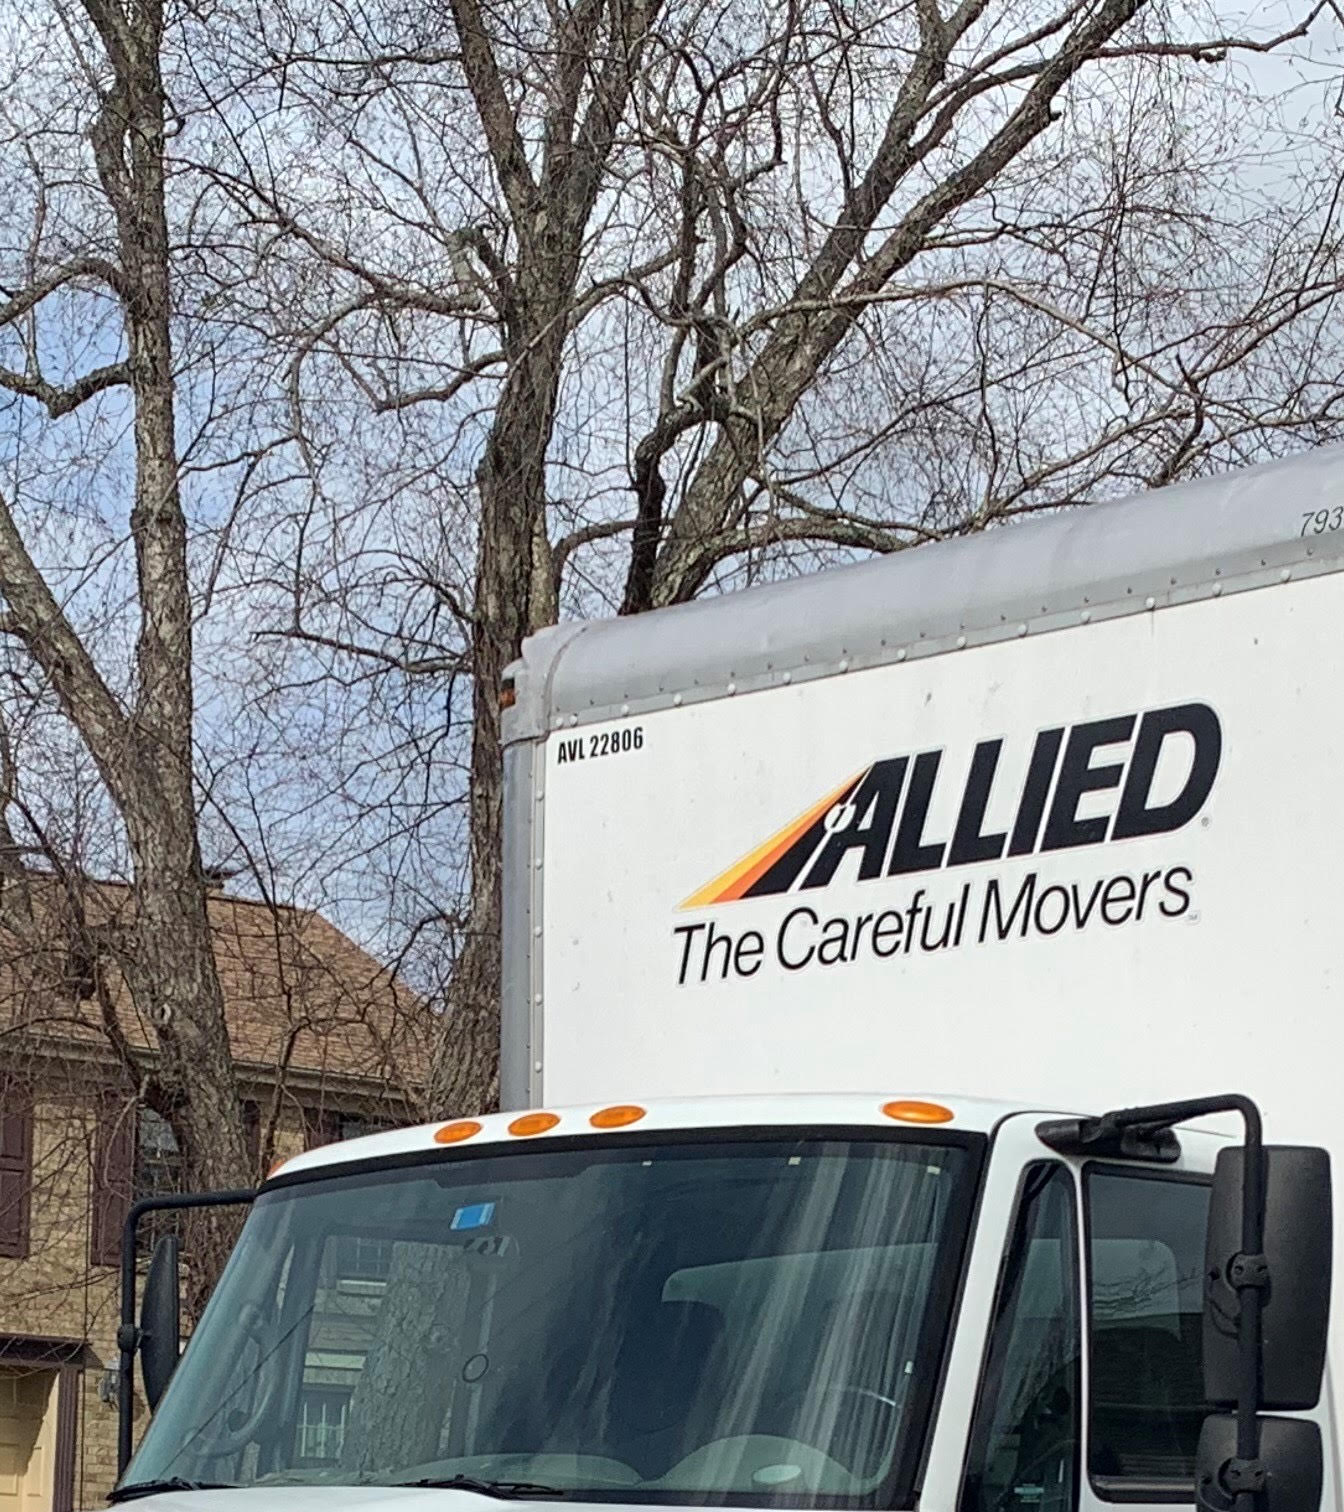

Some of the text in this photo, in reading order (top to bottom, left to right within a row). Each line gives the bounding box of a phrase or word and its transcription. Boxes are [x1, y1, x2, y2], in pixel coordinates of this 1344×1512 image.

[558, 726, 643, 764] AVL 22806
[739, 702, 1223, 900] ALLIED
[674, 866, 1193, 984] The Careful Movers
